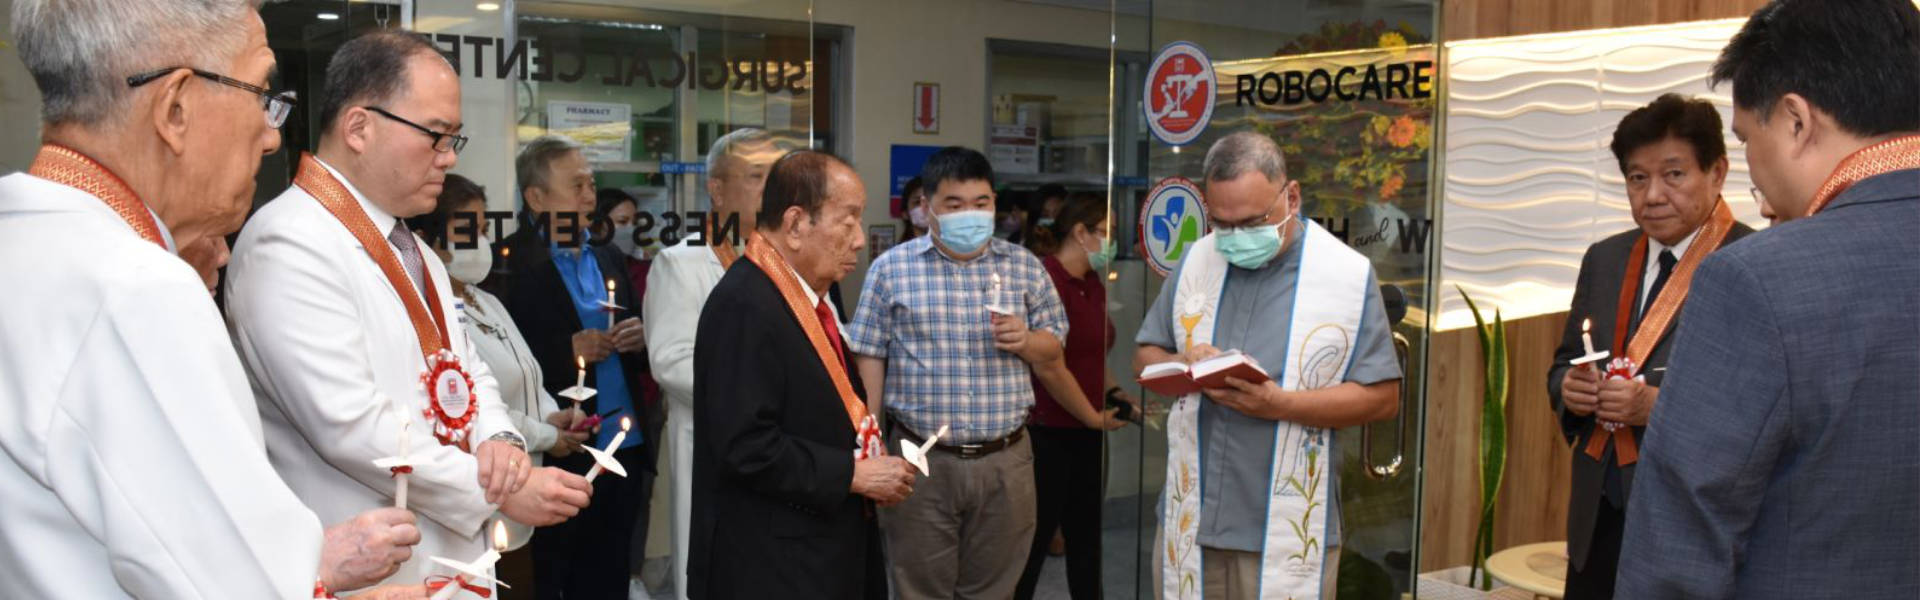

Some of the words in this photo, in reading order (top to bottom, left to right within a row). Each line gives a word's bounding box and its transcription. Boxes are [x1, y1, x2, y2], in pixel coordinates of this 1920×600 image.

[1236, 61, 1432, 107] ROBOCARE
[566, 106, 611, 116] PHARMACY
[1354, 217, 1390, 247] and
[1398, 218, 1432, 254] W
